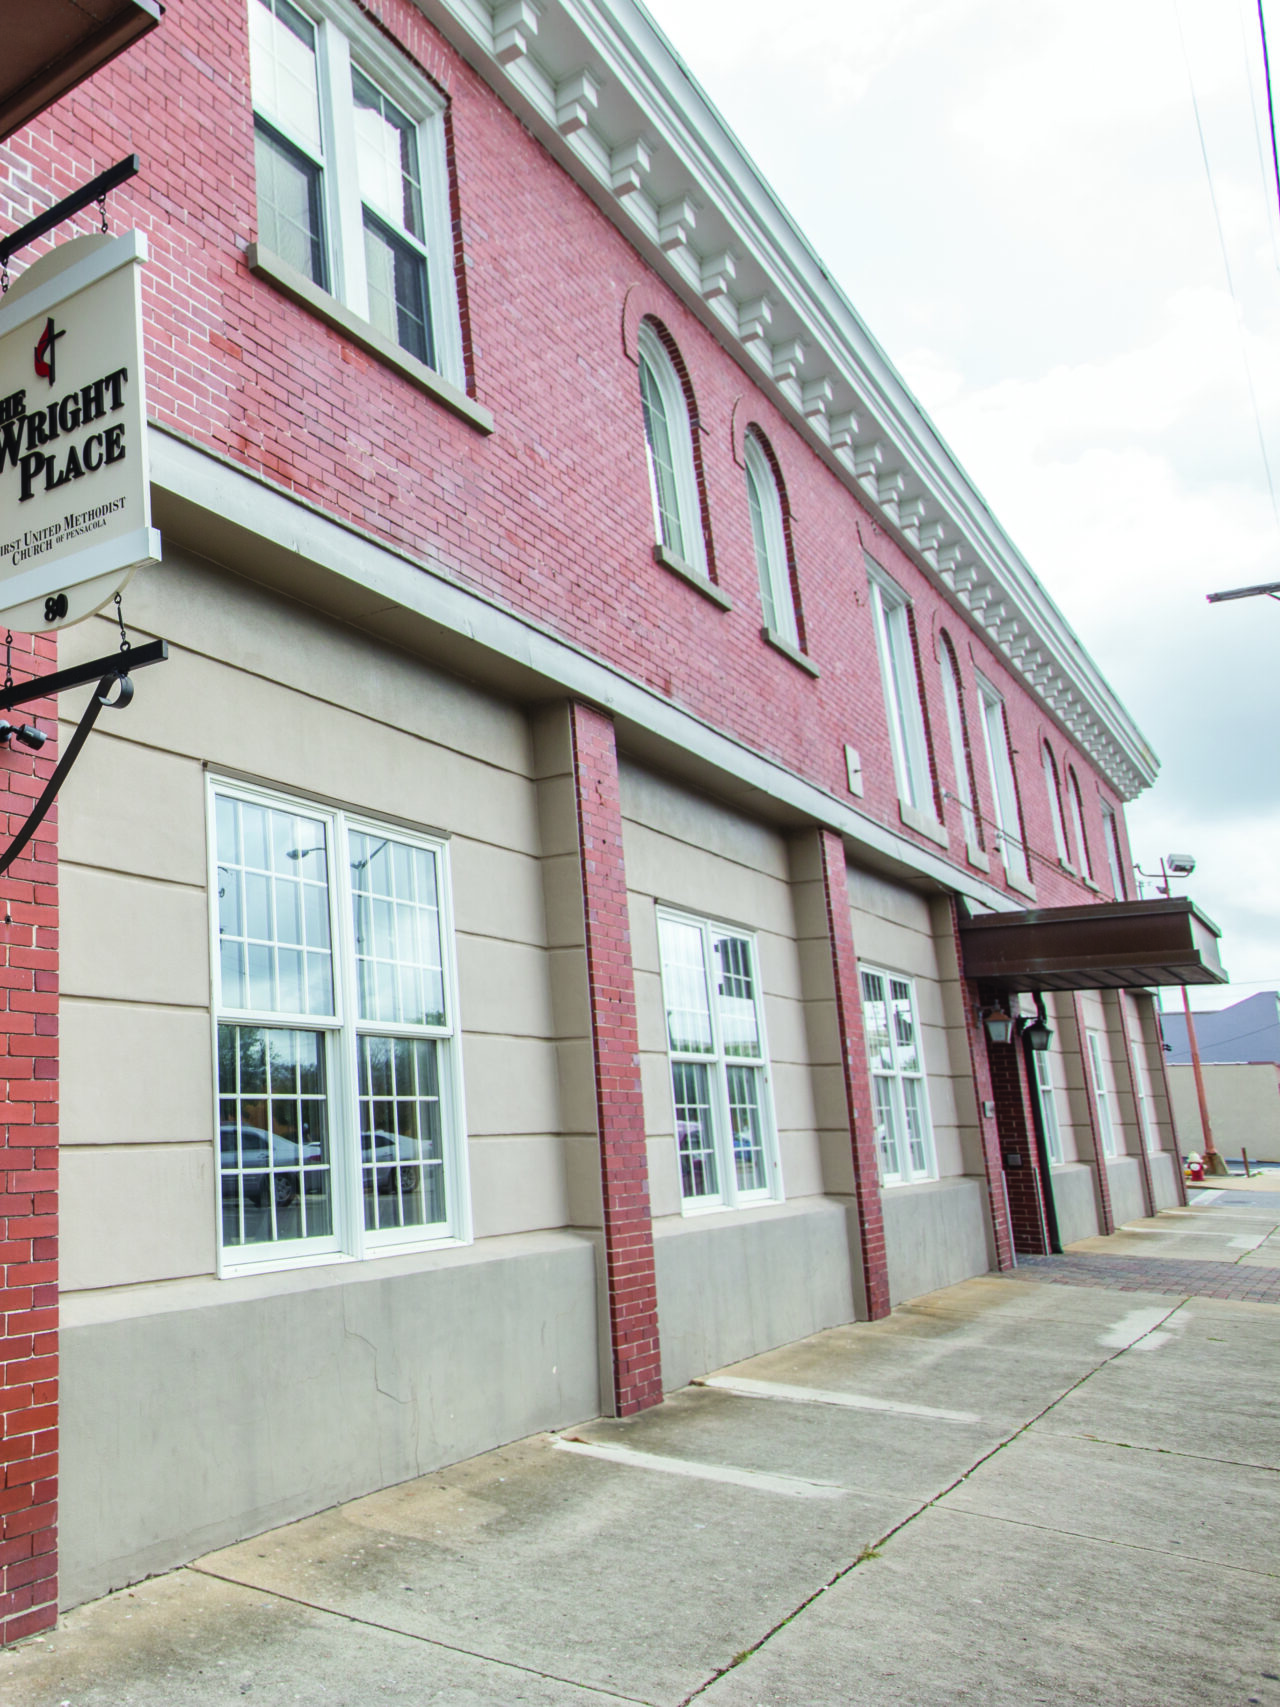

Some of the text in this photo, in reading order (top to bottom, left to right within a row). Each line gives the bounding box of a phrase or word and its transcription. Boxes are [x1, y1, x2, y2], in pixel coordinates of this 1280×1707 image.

[18, 422, 126, 502] PLACE
[12, 518, 107, 566] CHURCH OF PENSACOLA
[24, 523, 62, 547] UNITED
[64, 496, 126, 532] METHODIST
[44, 593, 69, 622] 80
